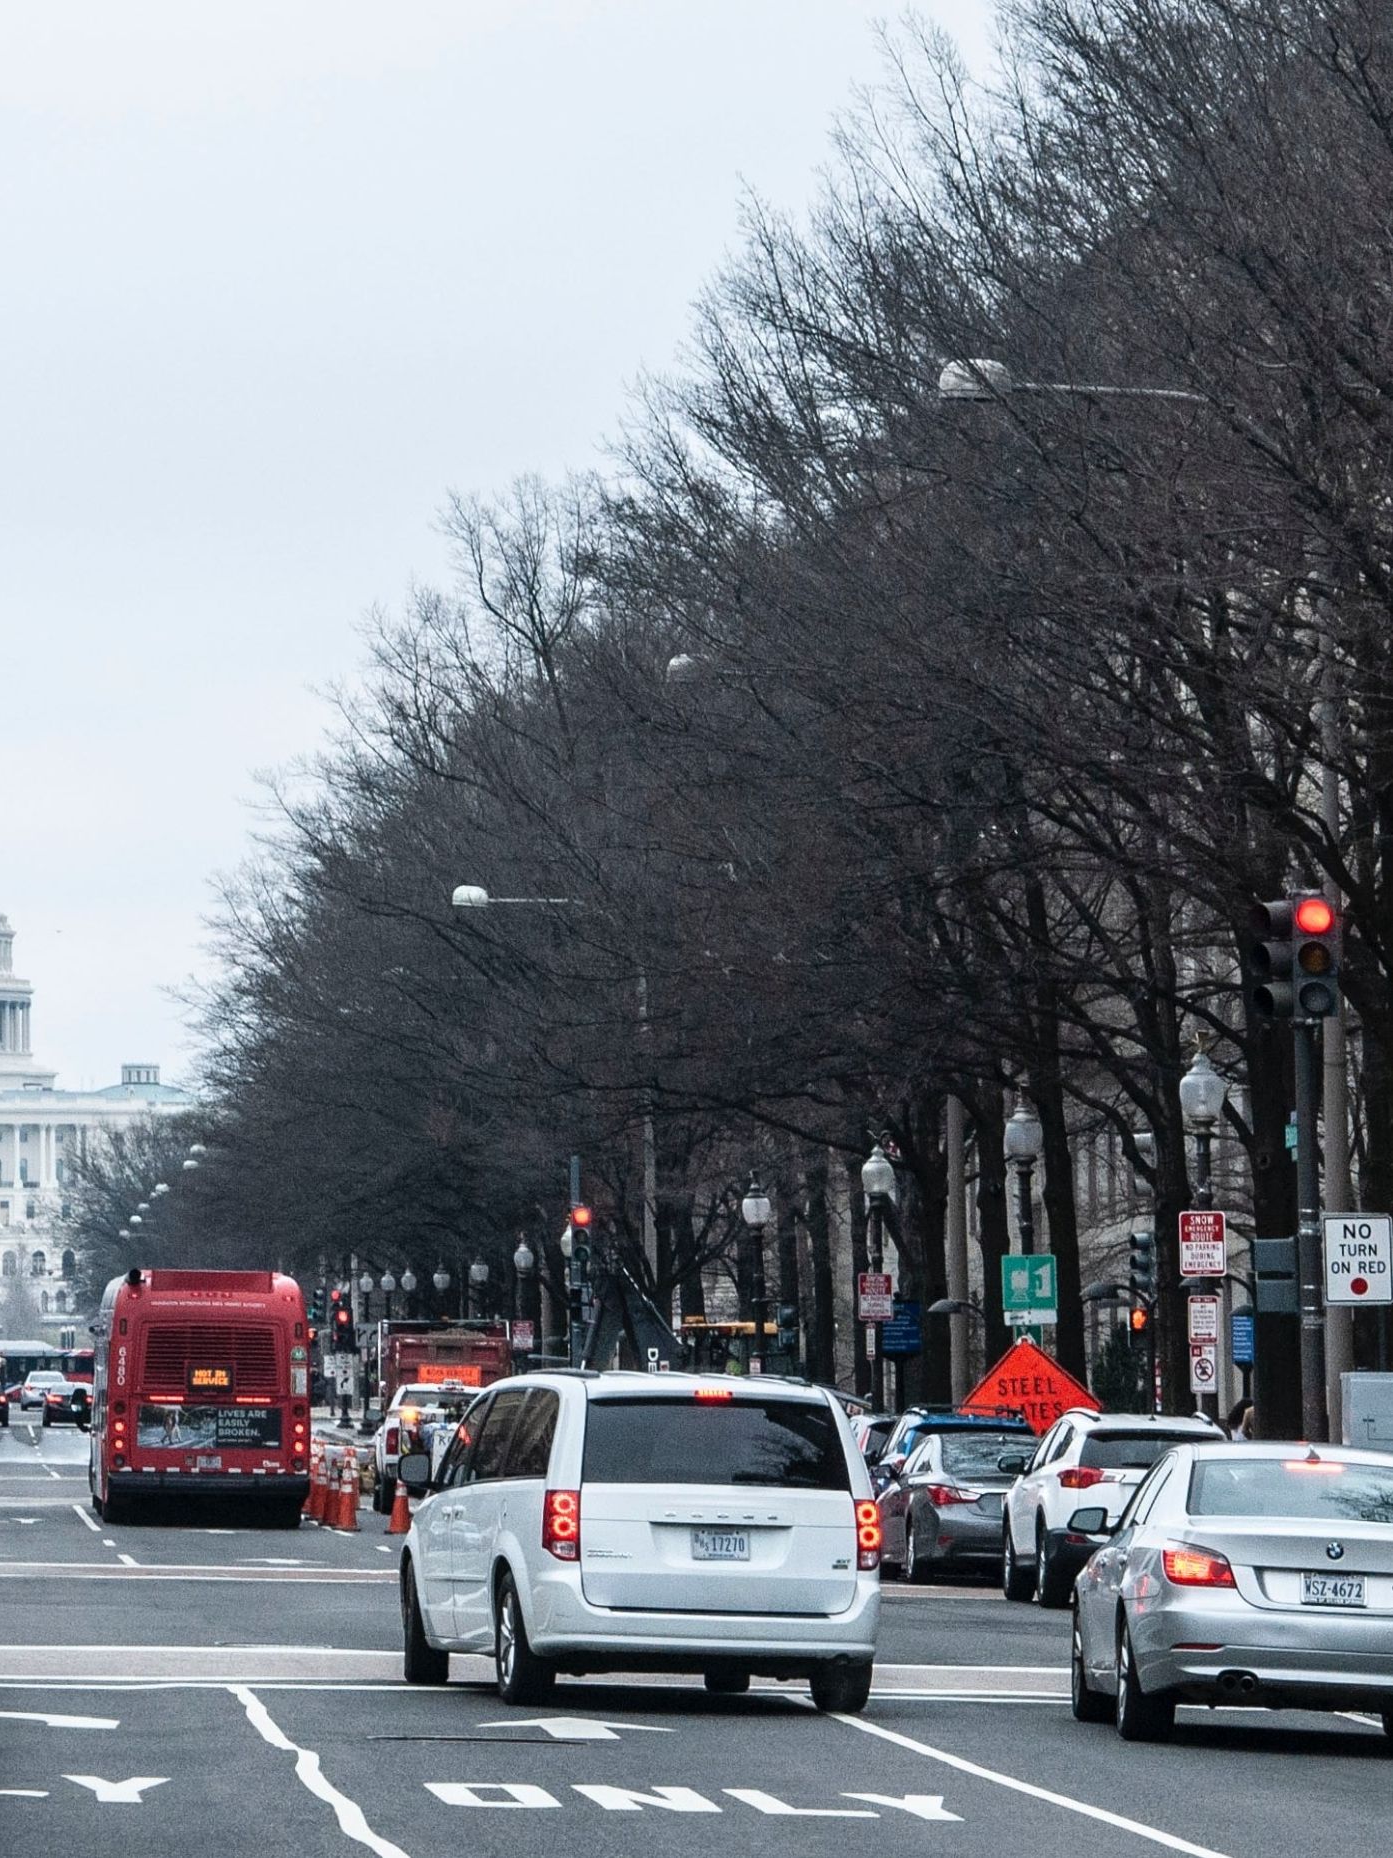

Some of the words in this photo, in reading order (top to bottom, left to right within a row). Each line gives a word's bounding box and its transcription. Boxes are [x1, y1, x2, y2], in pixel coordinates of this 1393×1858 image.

[1190, 1215, 1214, 1225] SNOW
[1343, 1224, 1372, 1239] NO
[1190, 1233, 1214, 1241] ROUTE
[1339, 1244, 1377, 1257] TURN
[1190, 1252, 1215, 1260] DURING
[1184, 1261, 1221, 1269] EMERGENCY
[1330, 1261, 1351, 1275] ON
[1358, 1261, 1386, 1274] RED
[117, 1346, 127, 1386] 6480
[194, 1369, 212, 1377] NOT
[214, 1369, 226, 1377] IN
[192, 1377, 229, 1385] SERVICE
[998, 1377, 1057, 1396] STEEL
[218, 1410, 246, 1418] LIVES
[247, 1410, 268, 1418] ARE
[218, 1419, 250, 1427] EASILY
[218, 1428, 261, 1437] BROKEN.
[712, 1537, 745, 1552] 17270
[1305, 1580, 1362, 1598] WSZ-4672
[423, 1783, 966, 1821] ONLY
